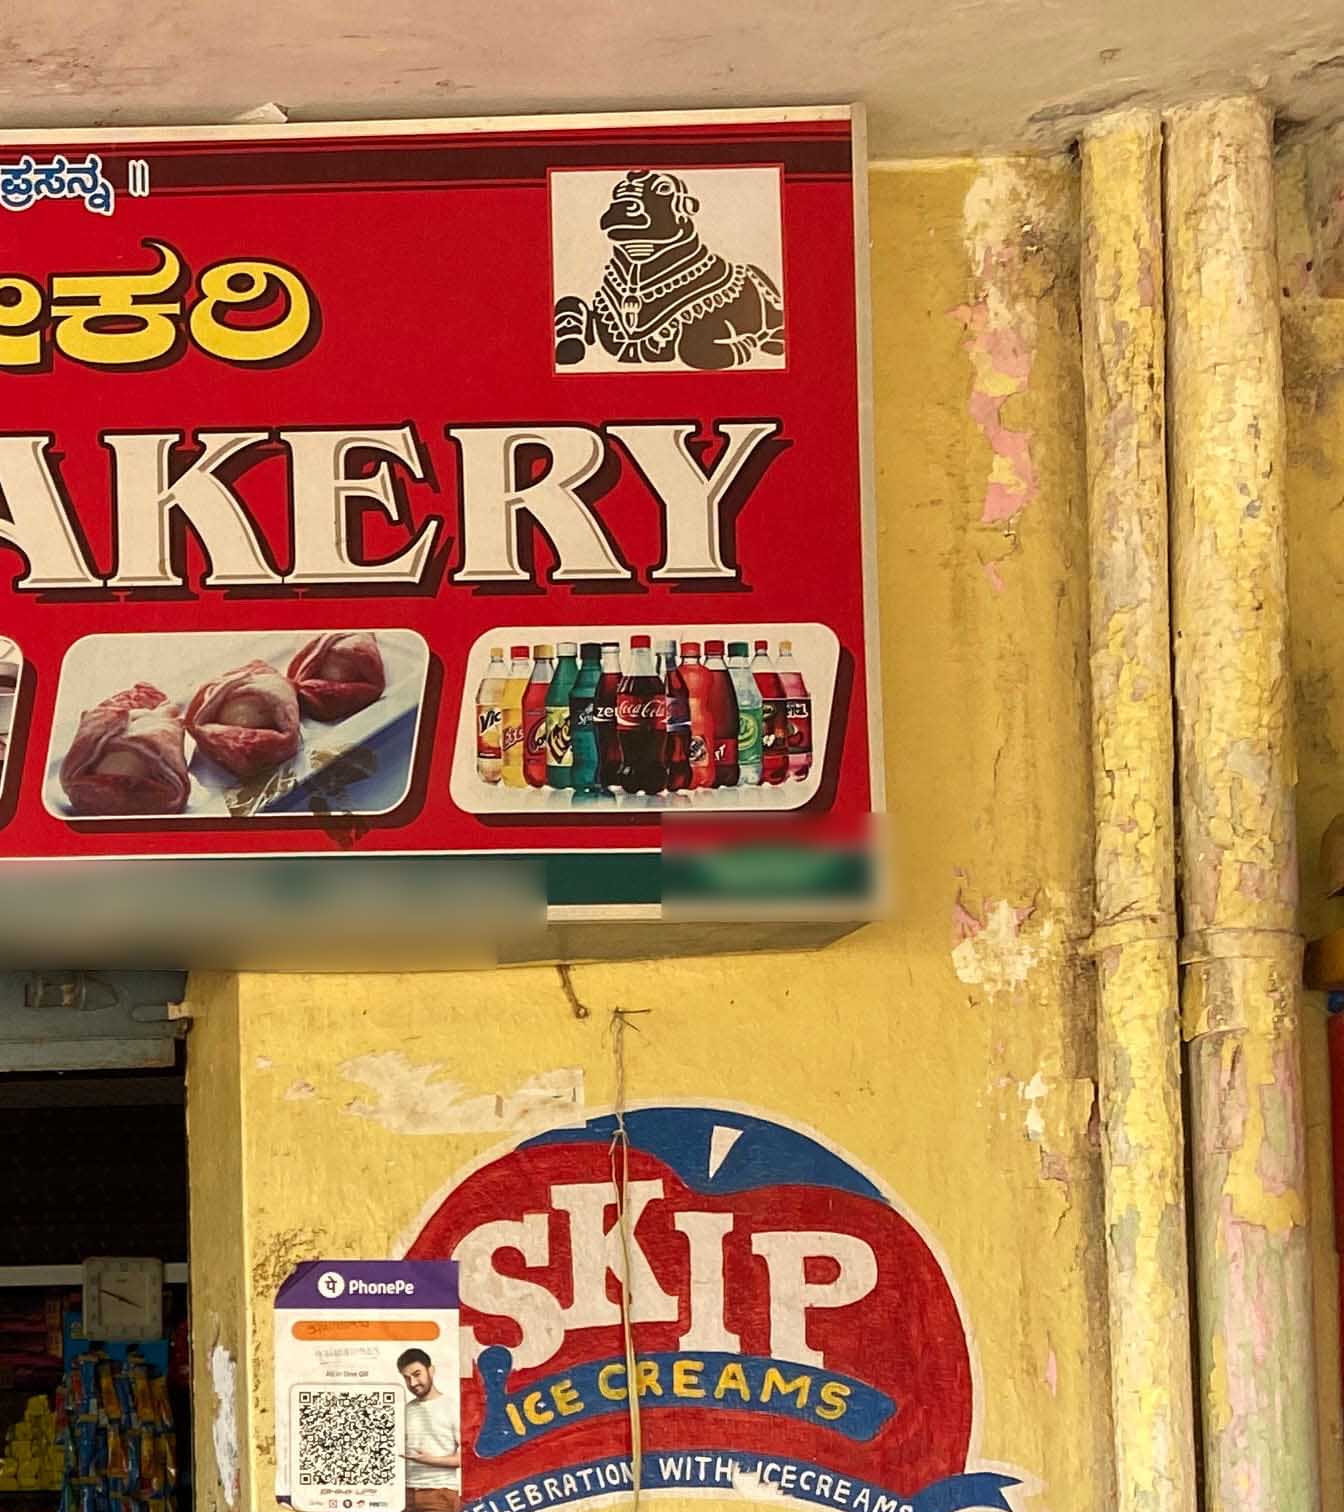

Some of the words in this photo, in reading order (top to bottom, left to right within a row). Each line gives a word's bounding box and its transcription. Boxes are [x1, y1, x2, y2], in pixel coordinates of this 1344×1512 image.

[0, 155, 114, 215] ಪ್ರಸನ್ನ
[348, 1279, 415, 1296] PhonePe
[451, 1179, 880, 1379] SKIP
[505, 1380, 585, 1434] ICE
[598, 1359, 852, 1422] CREAMS
[658, 1455, 734, 1482] WITH
